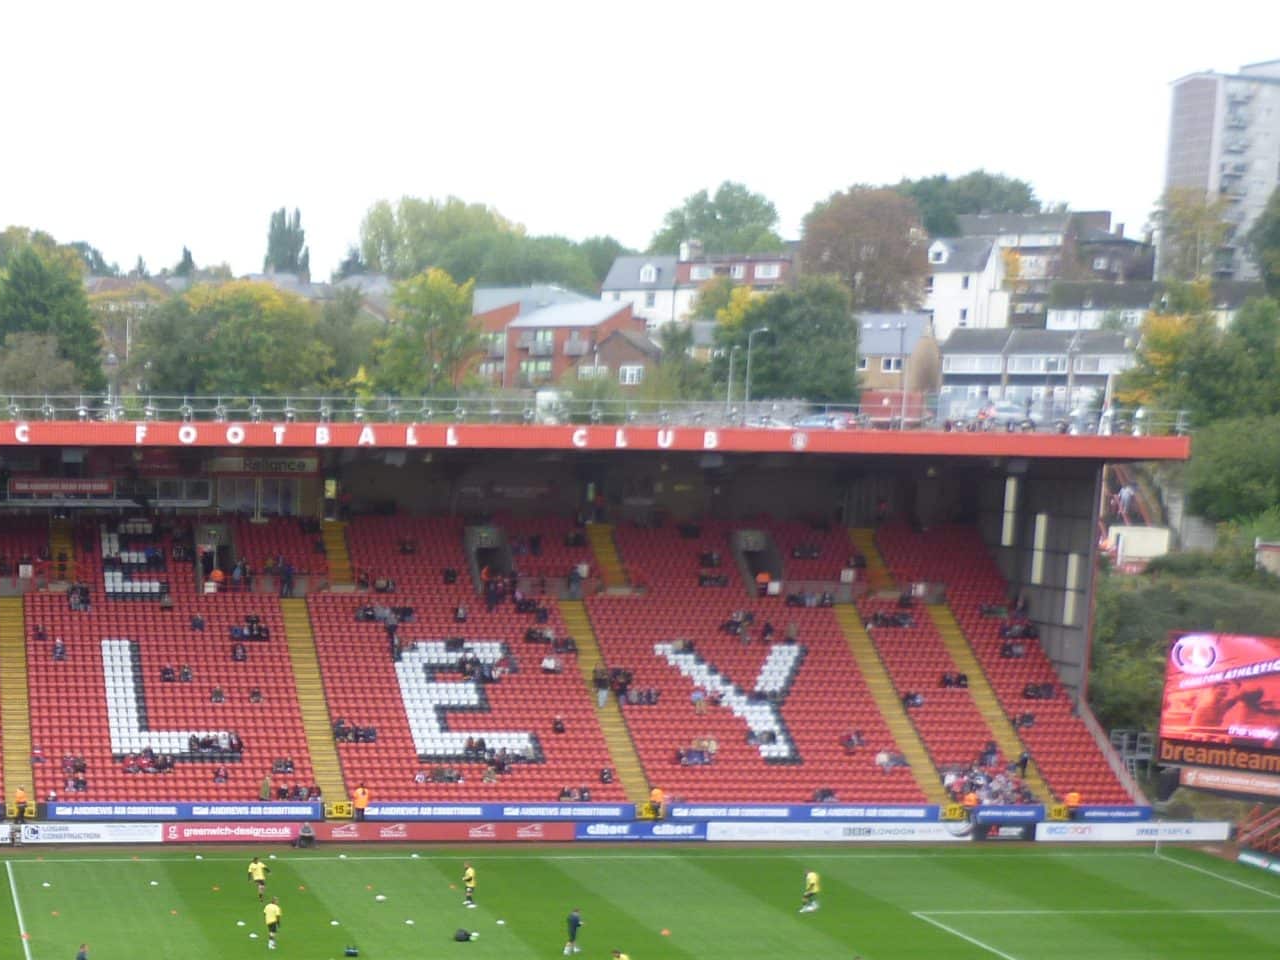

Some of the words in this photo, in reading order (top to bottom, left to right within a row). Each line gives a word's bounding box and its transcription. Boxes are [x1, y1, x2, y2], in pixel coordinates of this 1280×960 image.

[134, 424, 459, 446] FOOTBALL
[571, 428, 718, 450] CLUB
[183, 826, 291, 838] greenwich-design.co.uk
